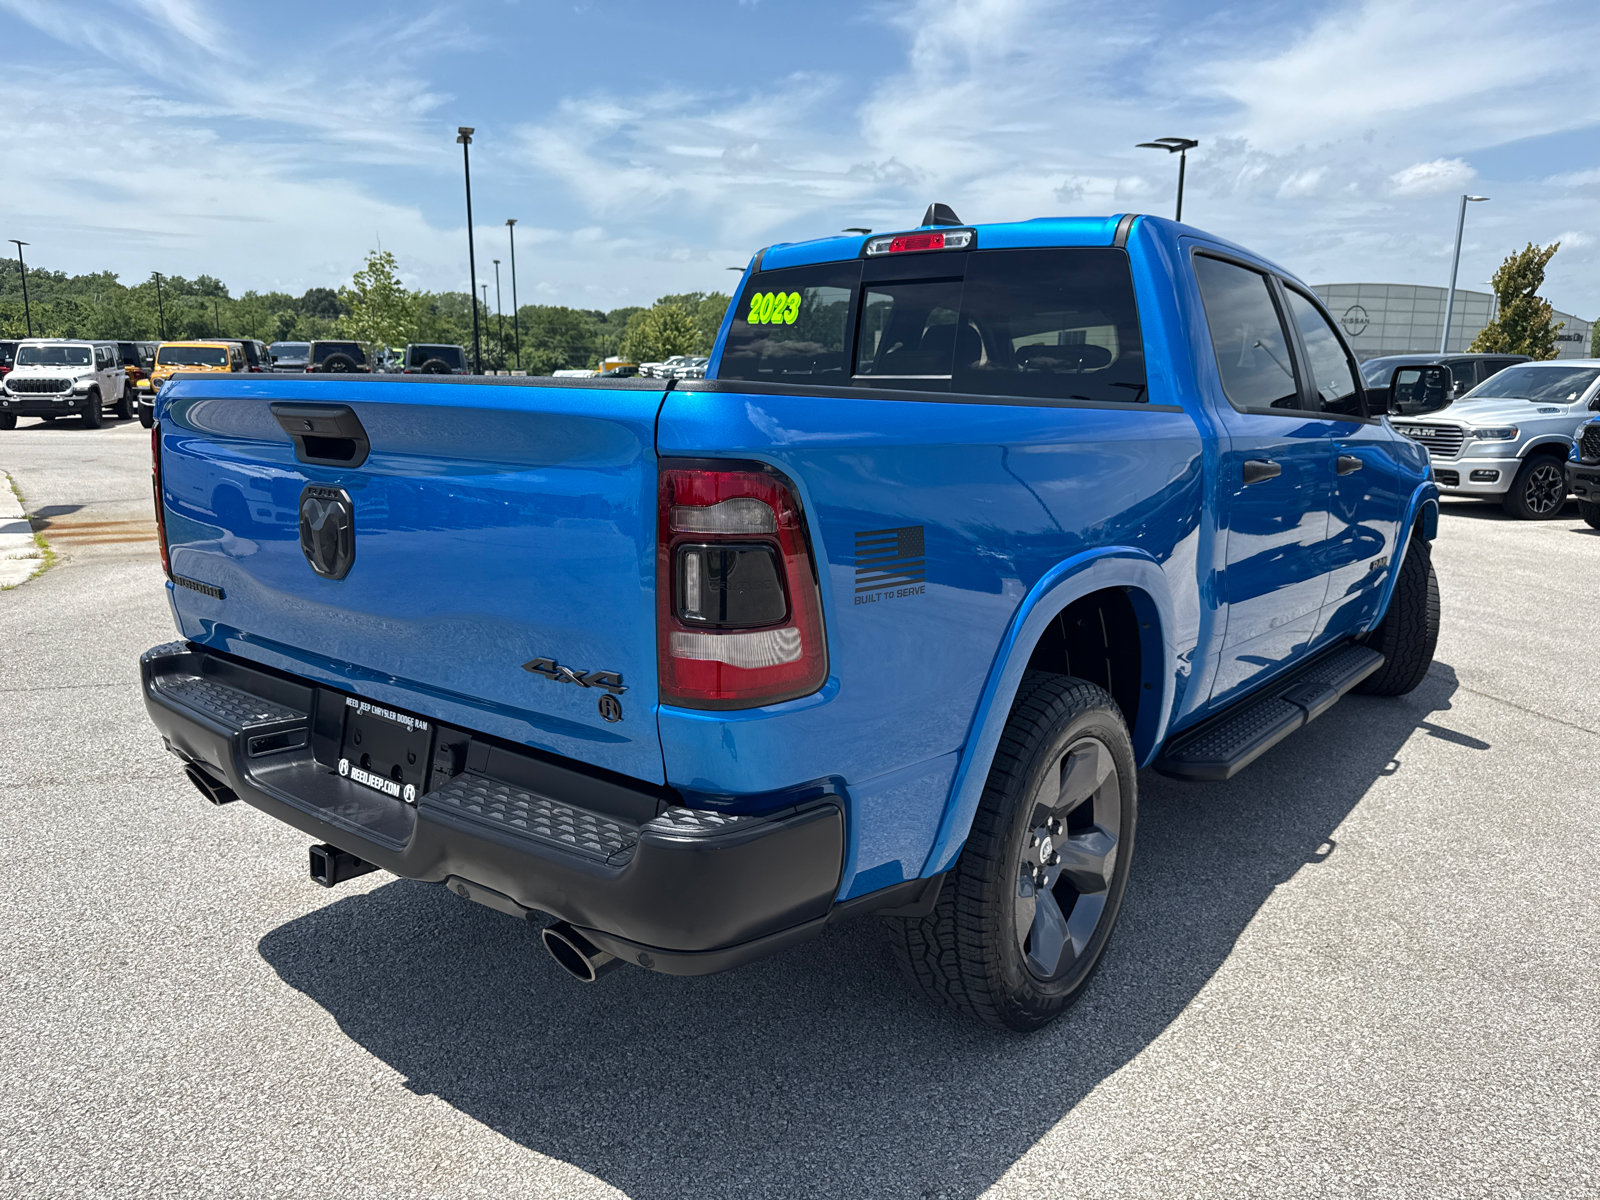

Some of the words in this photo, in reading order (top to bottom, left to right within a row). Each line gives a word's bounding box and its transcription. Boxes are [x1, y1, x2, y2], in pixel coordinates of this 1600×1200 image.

[747, 291, 801, 325] 2023
[1398, 427, 1436, 437] RAM
[308, 487, 339, 498] RAM
[854, 592, 882, 606] BUILT
[884, 591, 895, 600] TO
[896, 585, 926, 598] SERVE
[346, 697, 359, 708] REED
[360, 701, 371, 712] JEEP
[371, 705, 396, 721] CHRYSLER
[396, 713, 414, 727] DODGE
[414, 718, 428, 731] RAM
[351, 767, 400, 797] REEDJEEP.COM
